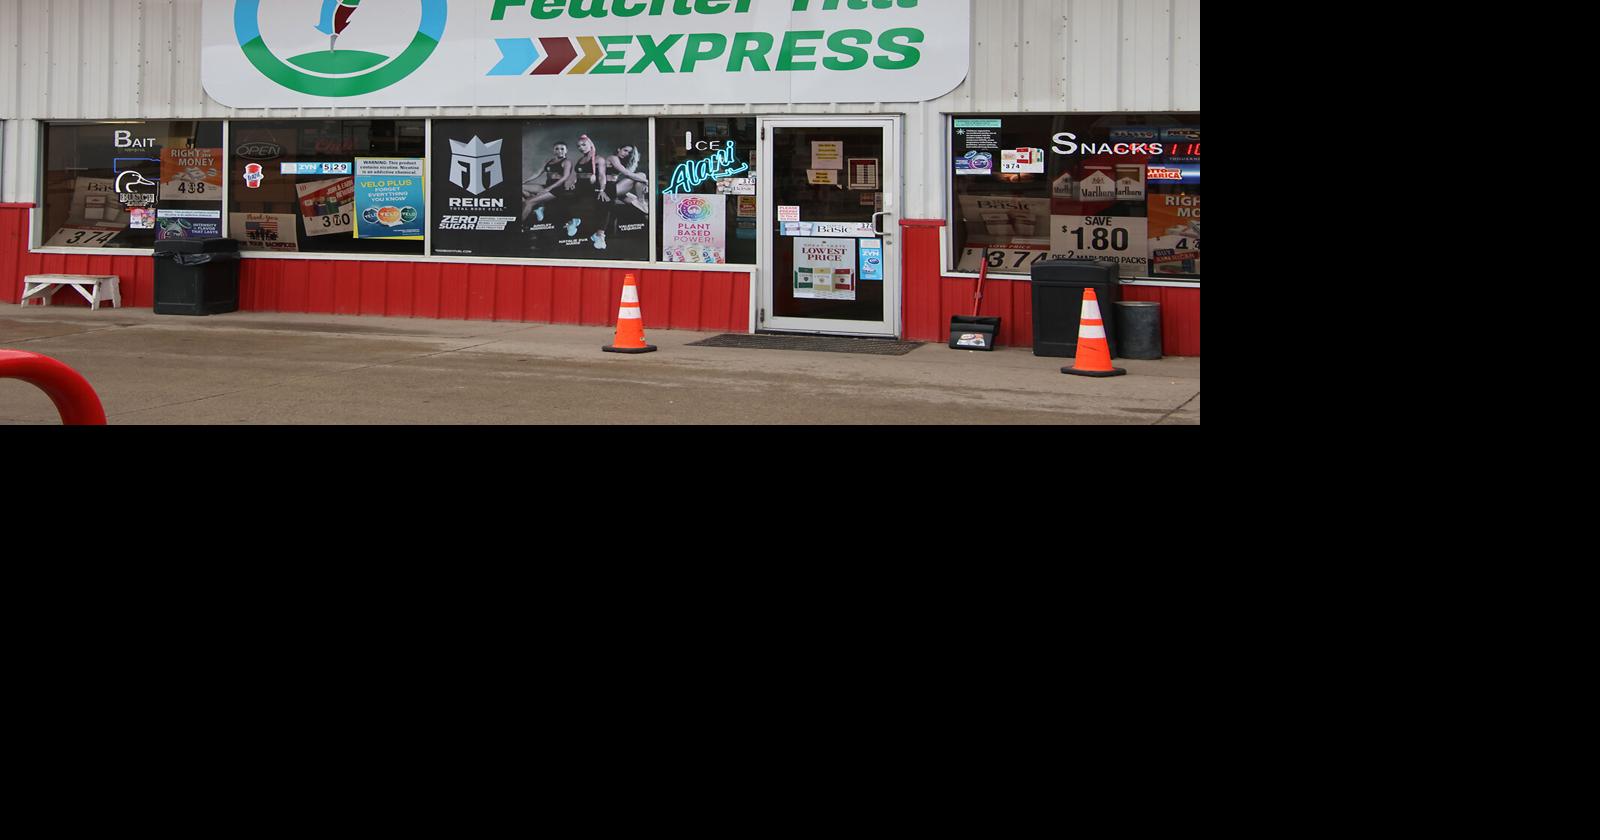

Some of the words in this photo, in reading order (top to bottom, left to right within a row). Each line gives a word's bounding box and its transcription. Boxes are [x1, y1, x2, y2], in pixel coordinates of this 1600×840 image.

[588, 27, 925, 74] EXPRESS
[114, 130, 156, 148] BAIT
[685, 131, 720, 150] ICE
[1051, 132, 1164, 155] SNACKS
[171, 150, 200, 158] RIGHT
[236, 143, 280, 157] OPEN
[178, 158, 214, 166] MONEY
[361, 180, 385, 188] VELO
[386, 179, 412, 187] PLUS
[449, 198, 504, 207] REIGN
[977, 199, 1031, 210] Basic
[440, 215, 478, 224] ZERO
[1085, 216, 1113, 226] SAVE
[438, 223, 475, 231] SUGAR
[817, 225, 851, 234] Basic
[677, 229, 711, 237] BASED
[807, 254, 842, 262] PRICE
[1121, 257, 1147, 265] PACKS
